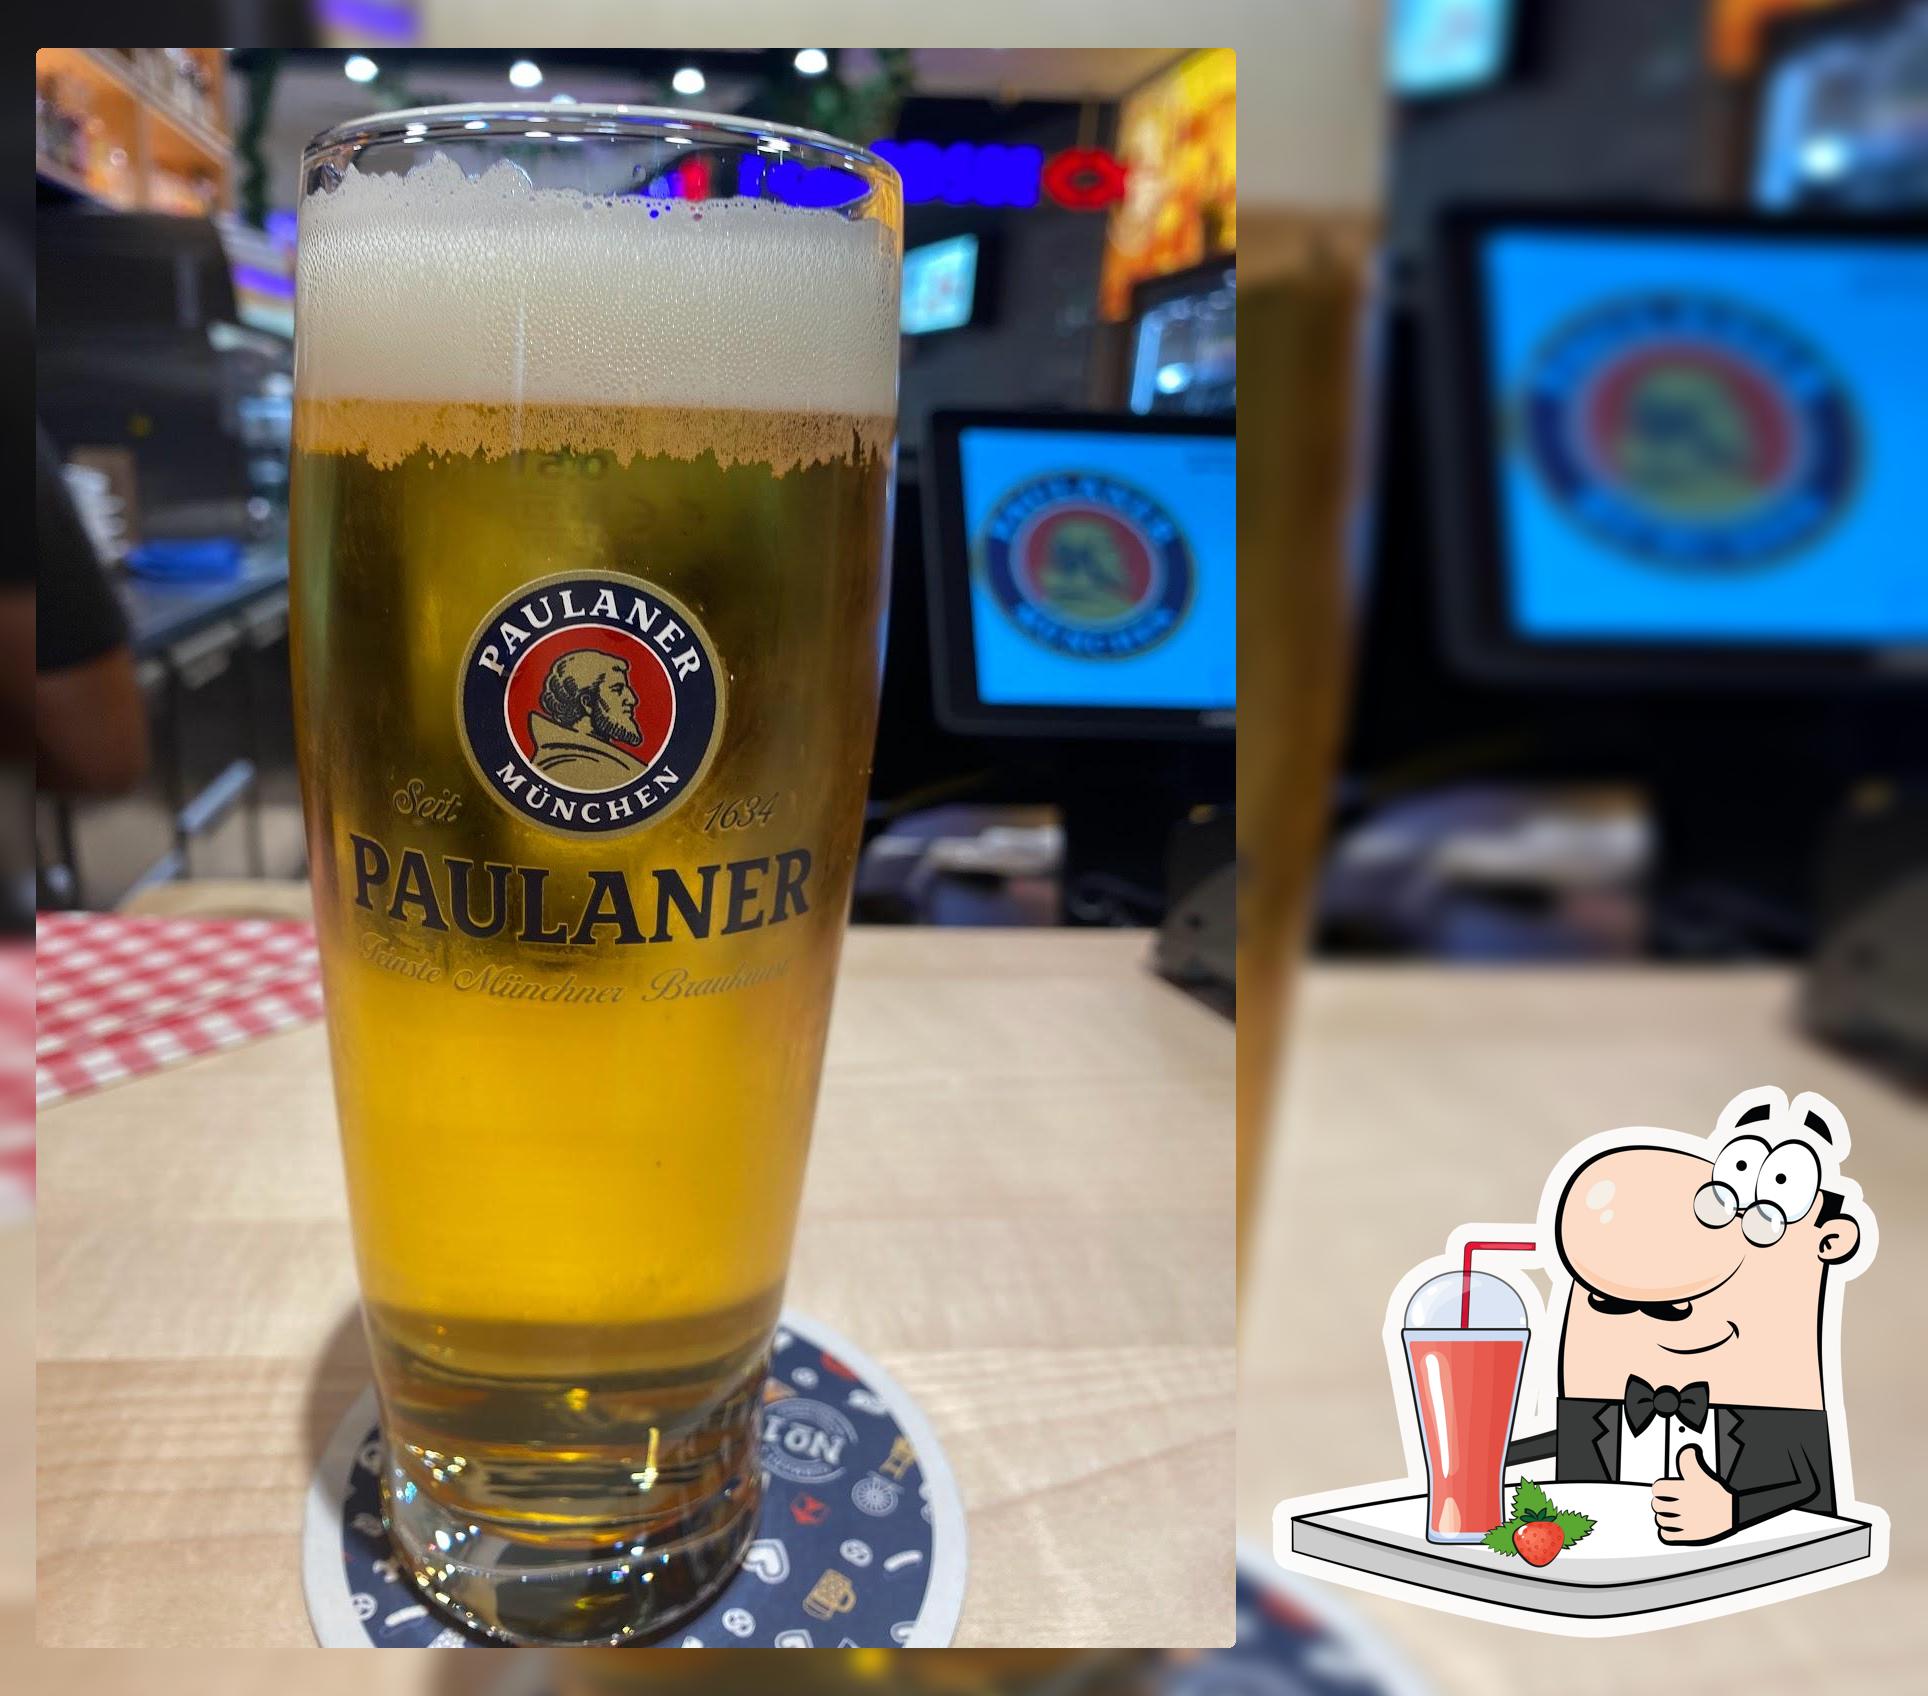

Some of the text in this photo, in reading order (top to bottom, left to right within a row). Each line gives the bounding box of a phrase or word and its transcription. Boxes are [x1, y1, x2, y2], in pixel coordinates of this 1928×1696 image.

[478, 588, 701, 682] PAULANER
[392, 777, 780, 834] Seit 1634
[495, 760, 680, 824] MÜNCHEN
[349, 832, 813, 946] PAULANER
[453, 963, 625, 1004] Münchner
